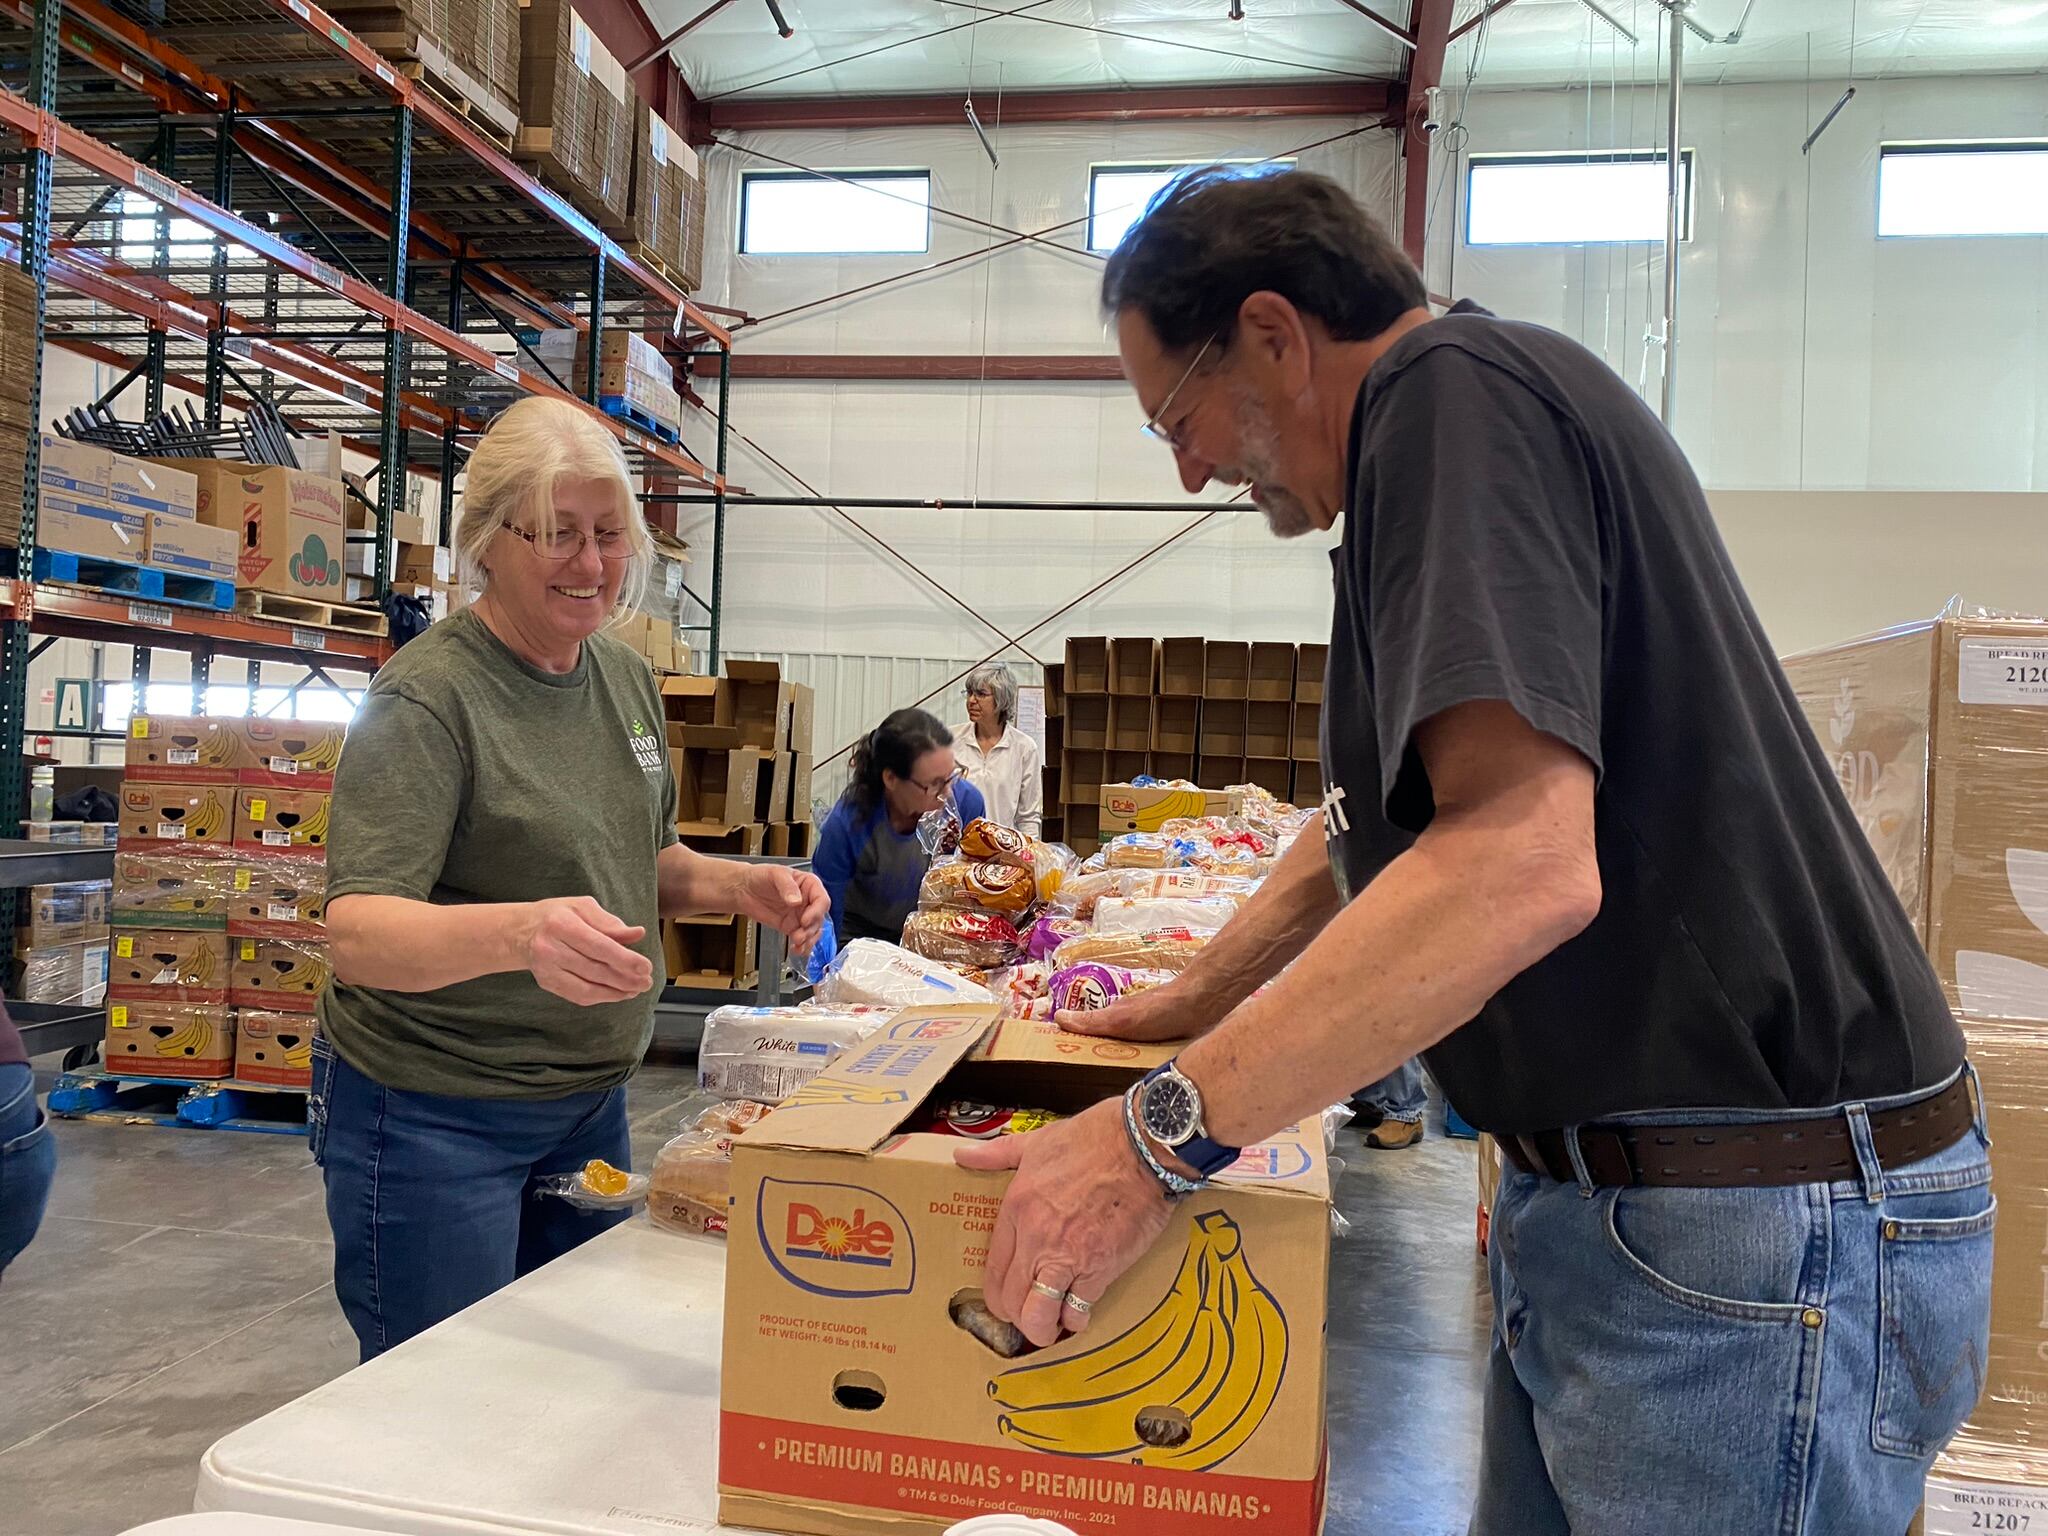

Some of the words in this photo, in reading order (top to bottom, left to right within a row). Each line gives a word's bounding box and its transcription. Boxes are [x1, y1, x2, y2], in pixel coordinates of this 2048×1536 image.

[153, 552, 174, 562] 89720
[2033, 651, 2048, 660] RE
[2006, 666, 2048, 683] 2120
[58, 684, 84, 726] A
[630, 735, 657, 752] FOOD
[635, 750, 662, 767] BANK
[129, 793, 149, 803] Dole
[1112, 800, 1135, 811] Dole
[917, 1020, 962, 1038] Dole
[753, 1037, 797, 1053] White
[845, 1044, 903, 1074] BANANAS
[880, 1045, 938, 1076] PREMIUM
[929, 1202, 964, 1216] DOLE
[967, 1206, 998, 1219] FRES
[786, 1203, 895, 1256] Dole
[963, 1221, 994, 1233] CHAR
[963, 1246, 990, 1256] AZOX
[963, 1258, 975, 1267] TO
[977, 1259, 986, 1268] M
[760, 1314, 804, 1328] PRODUCT
[807, 1320, 820, 1329] OF
[821, 1322, 868, 1336] ECUADOR
[759, 1327, 777, 1337] NET
[780, 1329, 821, 1343] WEIGHT:
[823, 1336, 834, 1345] 40
[836, 1338, 850, 1347] lbs
[852, 1339, 880, 1350] (18.14
[882, 1342, 897, 1354] kg)
[2002, 1383, 2048, 1404] Whe
[774, 1437, 882, 1474] PREMIUM
[890, 1453, 1001, 1489] BANANAS
[1020, 1470, 1135, 1506] PREMIUM
[1143, 1485, 1260, 1521] BANANAS
[950, 1494, 976, 1507] Dole
[977, 1497, 1006, 1512] Food
[1008, 1502, 1062, 1520] Company,
[1064, 1511, 1087, 1523] Inc.,
[1088, 1512, 1117, 1526] 2021
[1954, 1493, 1995, 1506] BREAD
[1998, 1497, 2048, 1510] REPACK
[1972, 1511, 2031, 1532] 21207
